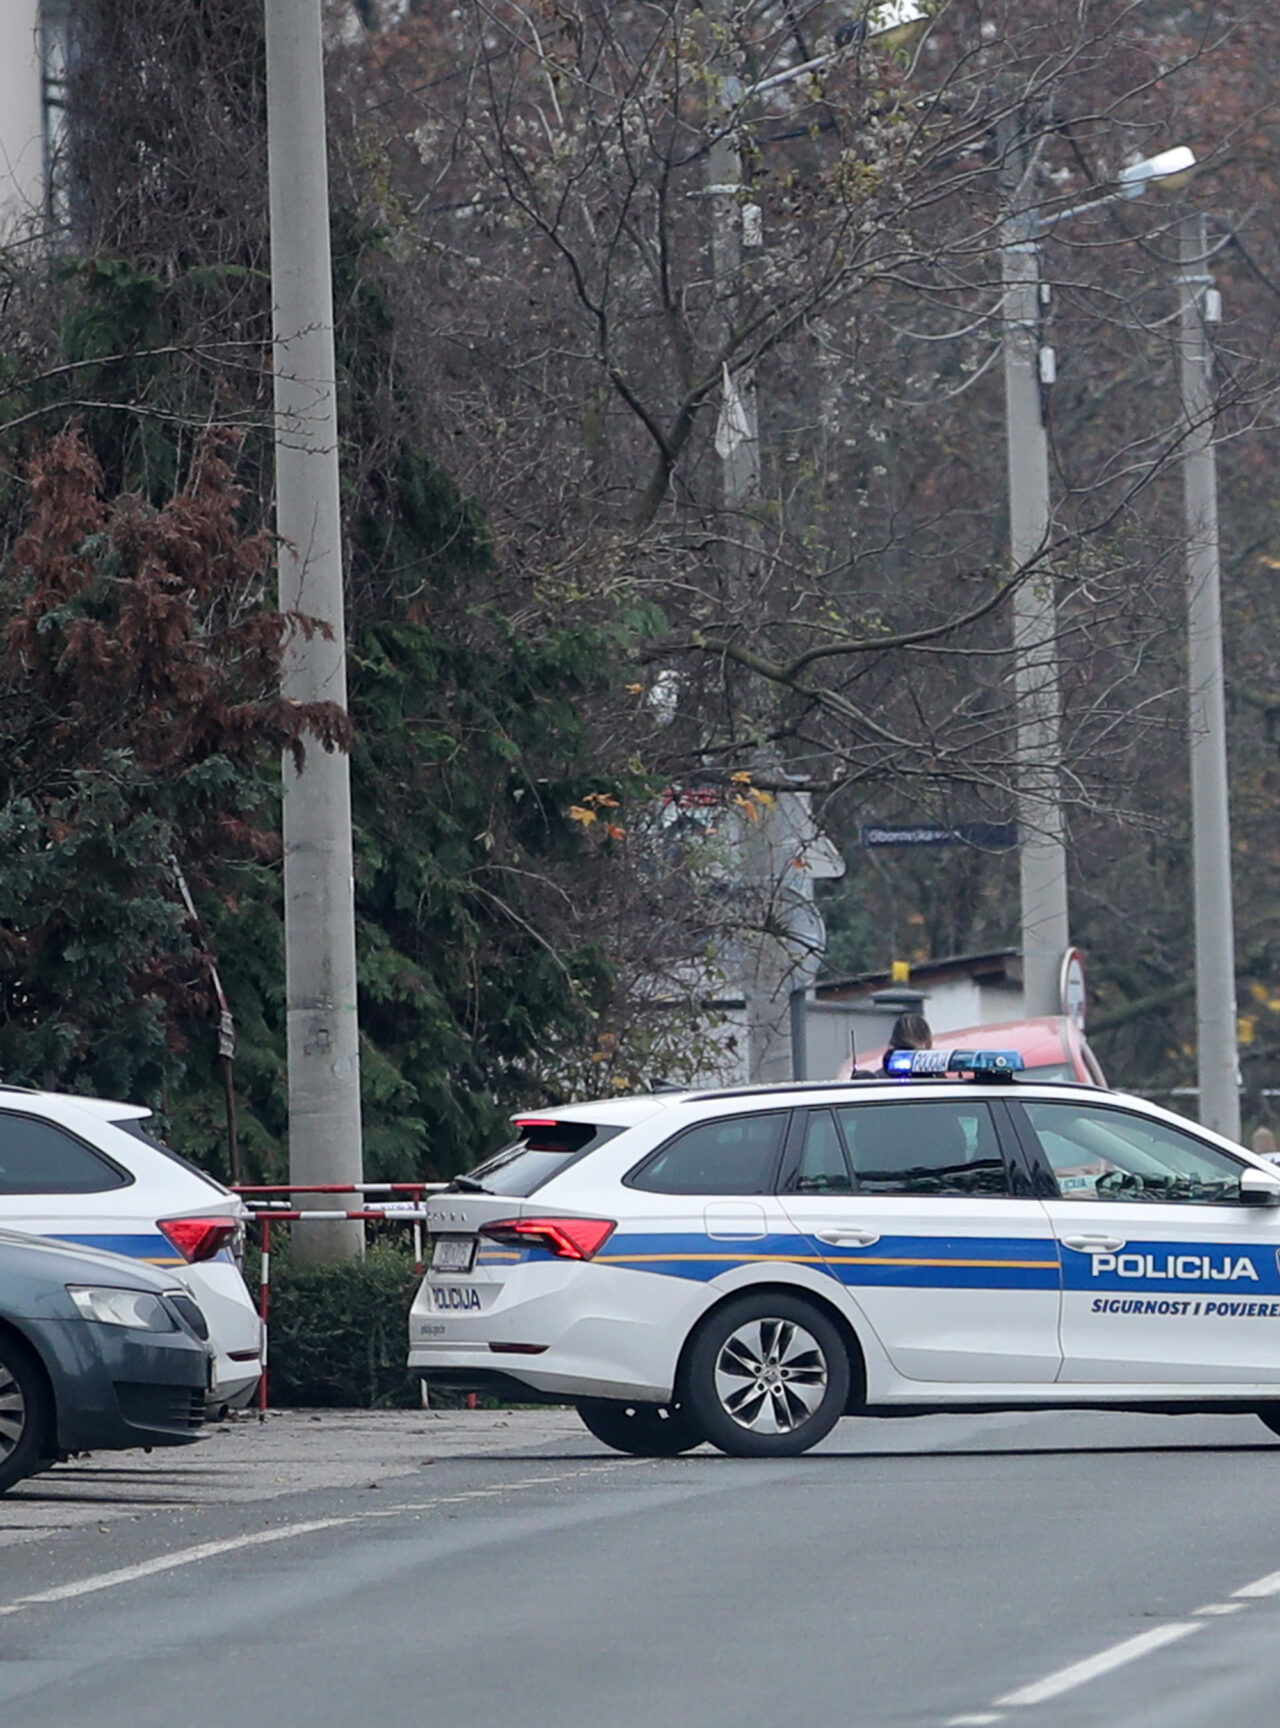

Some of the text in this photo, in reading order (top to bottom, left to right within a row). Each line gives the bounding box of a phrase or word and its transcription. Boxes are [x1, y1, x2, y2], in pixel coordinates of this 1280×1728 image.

[1091, 1254, 1259, 1280] POLICIJA
[1091, 1299, 1191, 1316] SIGURNOST
[1193, 1302, 1201, 1316] I
